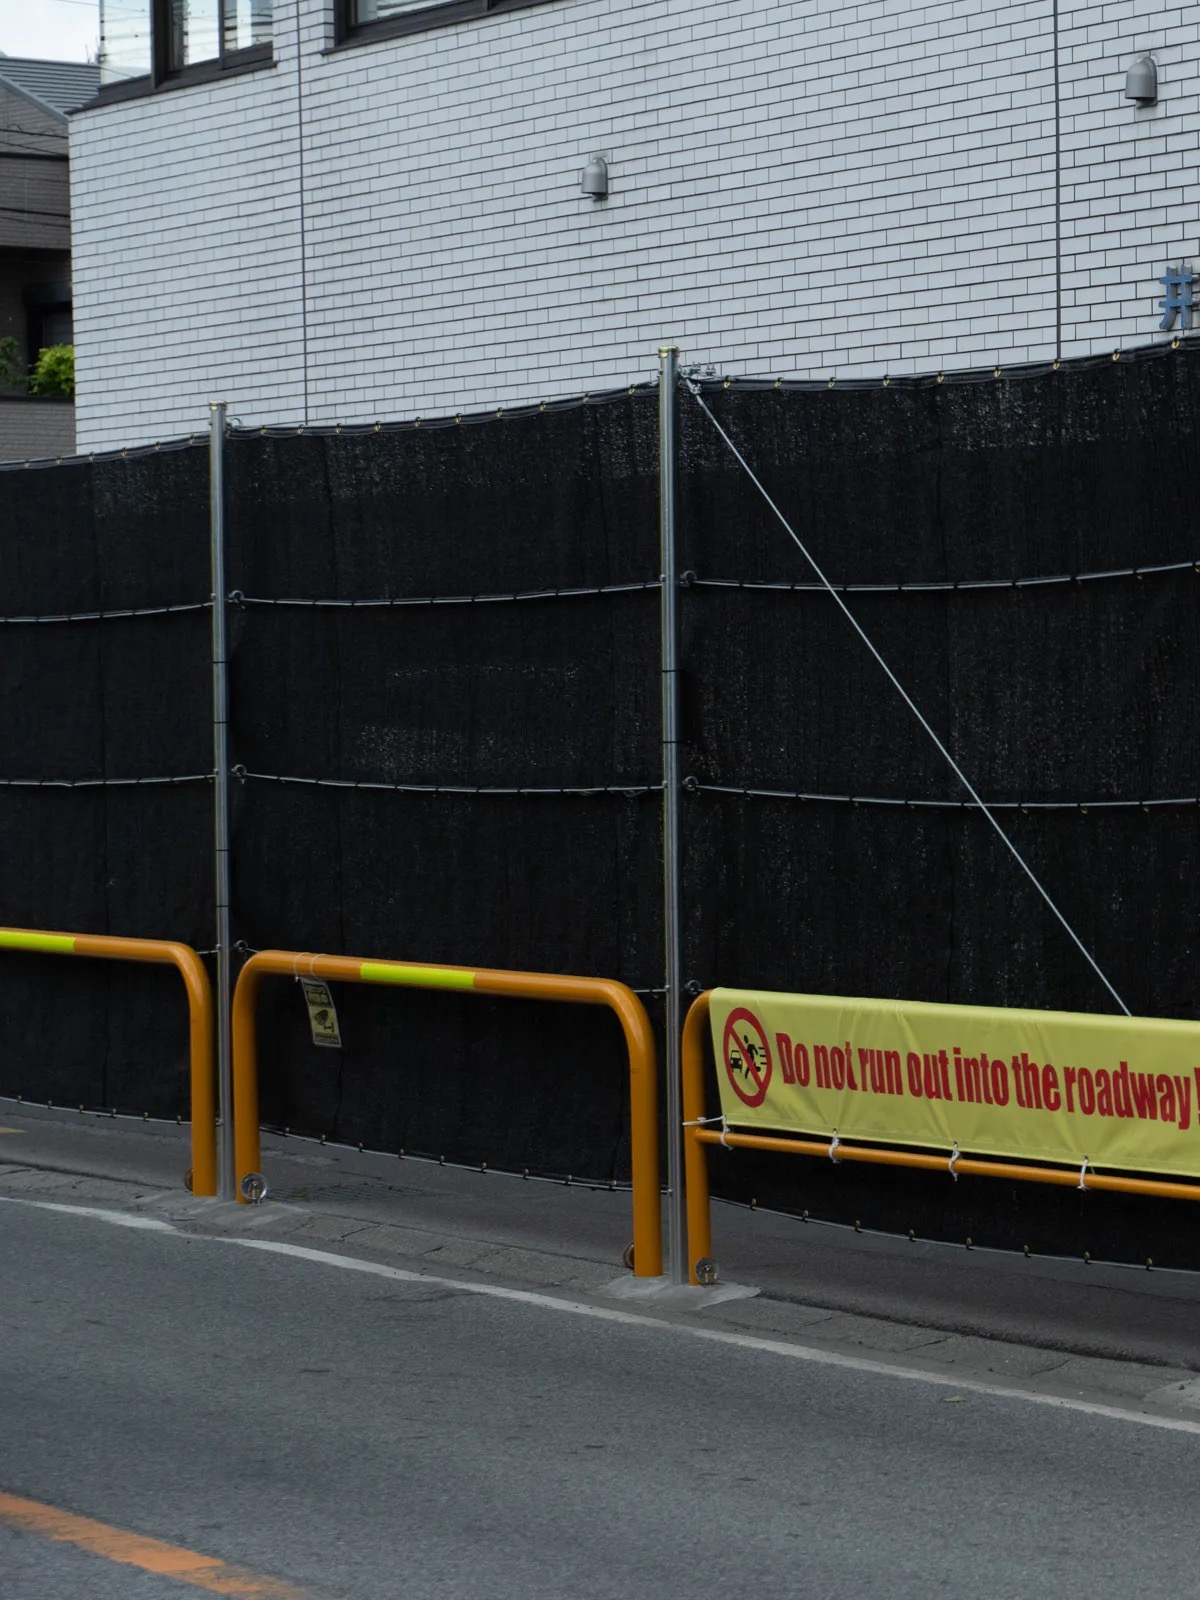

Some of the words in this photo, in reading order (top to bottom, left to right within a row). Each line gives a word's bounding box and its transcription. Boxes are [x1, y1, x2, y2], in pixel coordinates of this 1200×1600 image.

[775, 1033, 810, 1087] Do
[813, 1041, 858, 1090] not
[858, 1048, 904, 1095] run
[907, 1050, 953, 1101] out
[953, 1047, 1009, 1106] into
[1012, 1053, 1061, 1111] the
